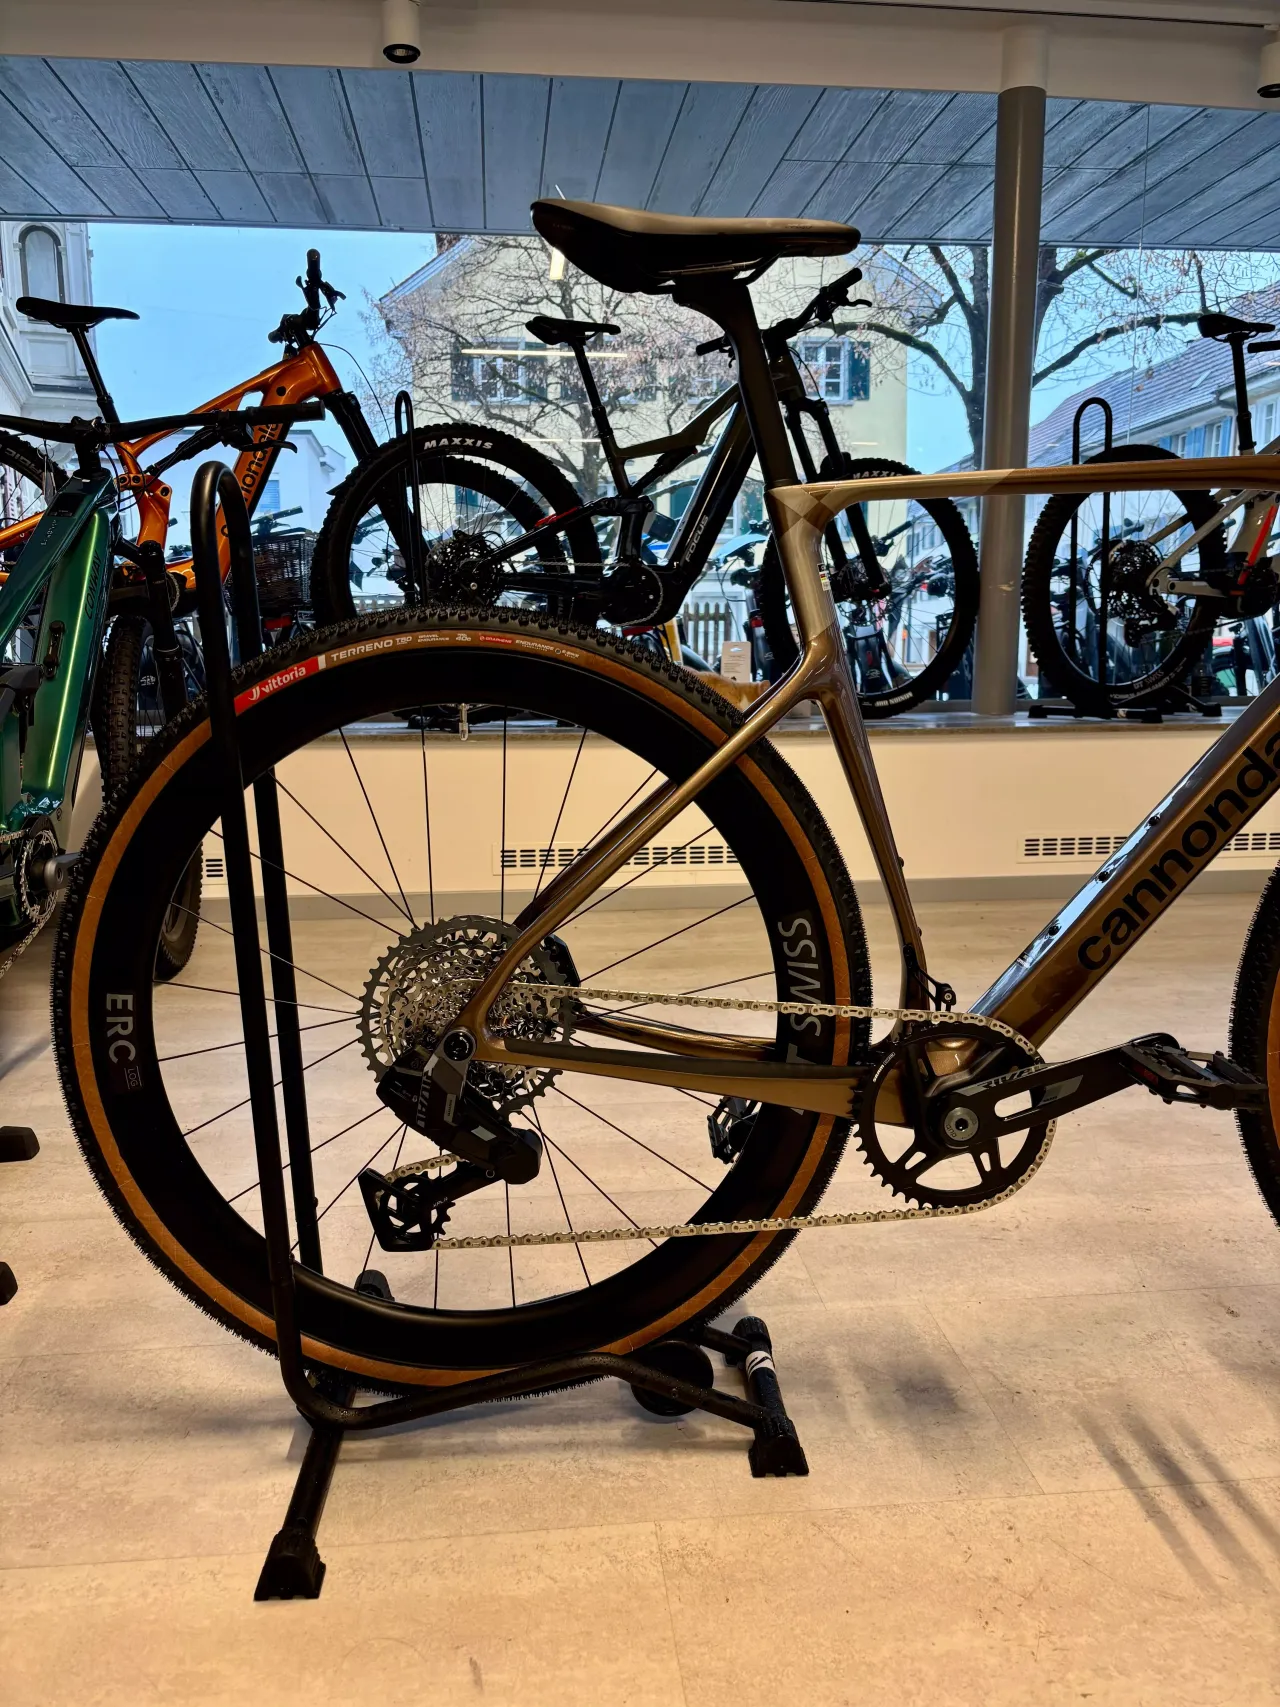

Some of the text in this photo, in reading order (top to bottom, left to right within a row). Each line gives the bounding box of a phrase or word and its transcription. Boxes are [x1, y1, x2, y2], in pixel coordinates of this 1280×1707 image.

[423, 438, 494, 450] MAXXIS
[685, 514, 709, 563] FOCUS
[84, 549, 101, 620] CONWAY
[261, 665, 307, 693] vittoria
[330, 639, 394, 662] TERRENO
[105, 992, 136, 1064] ERC
